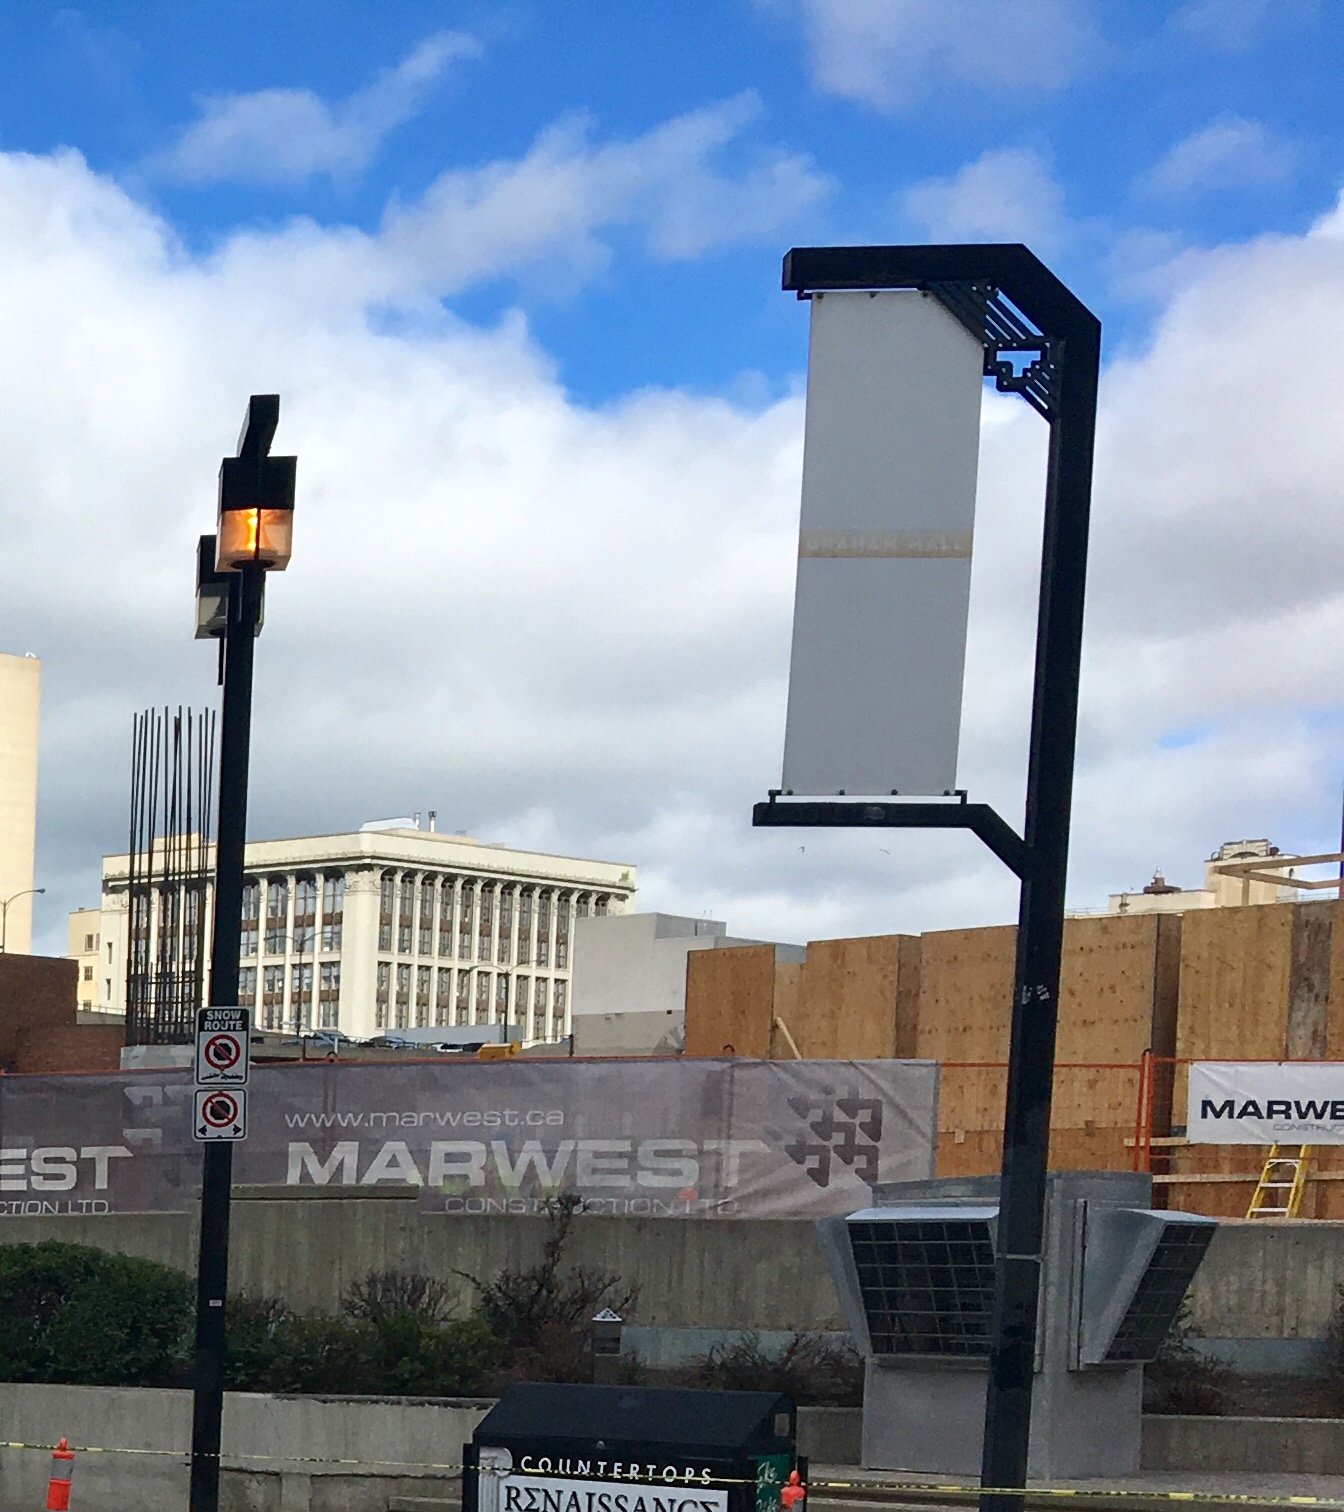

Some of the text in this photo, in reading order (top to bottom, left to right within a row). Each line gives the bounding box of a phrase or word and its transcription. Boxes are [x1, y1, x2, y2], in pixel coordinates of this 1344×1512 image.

[206, 1010, 242, 1020] SNOW
[204, 1020, 243, 1031] ROUTE
[285, 1108, 564, 1128] www.marwest.ca
[285, 1138, 777, 1190] MARWEST
[520, 1455, 712, 1485] COUNTERTOPS
